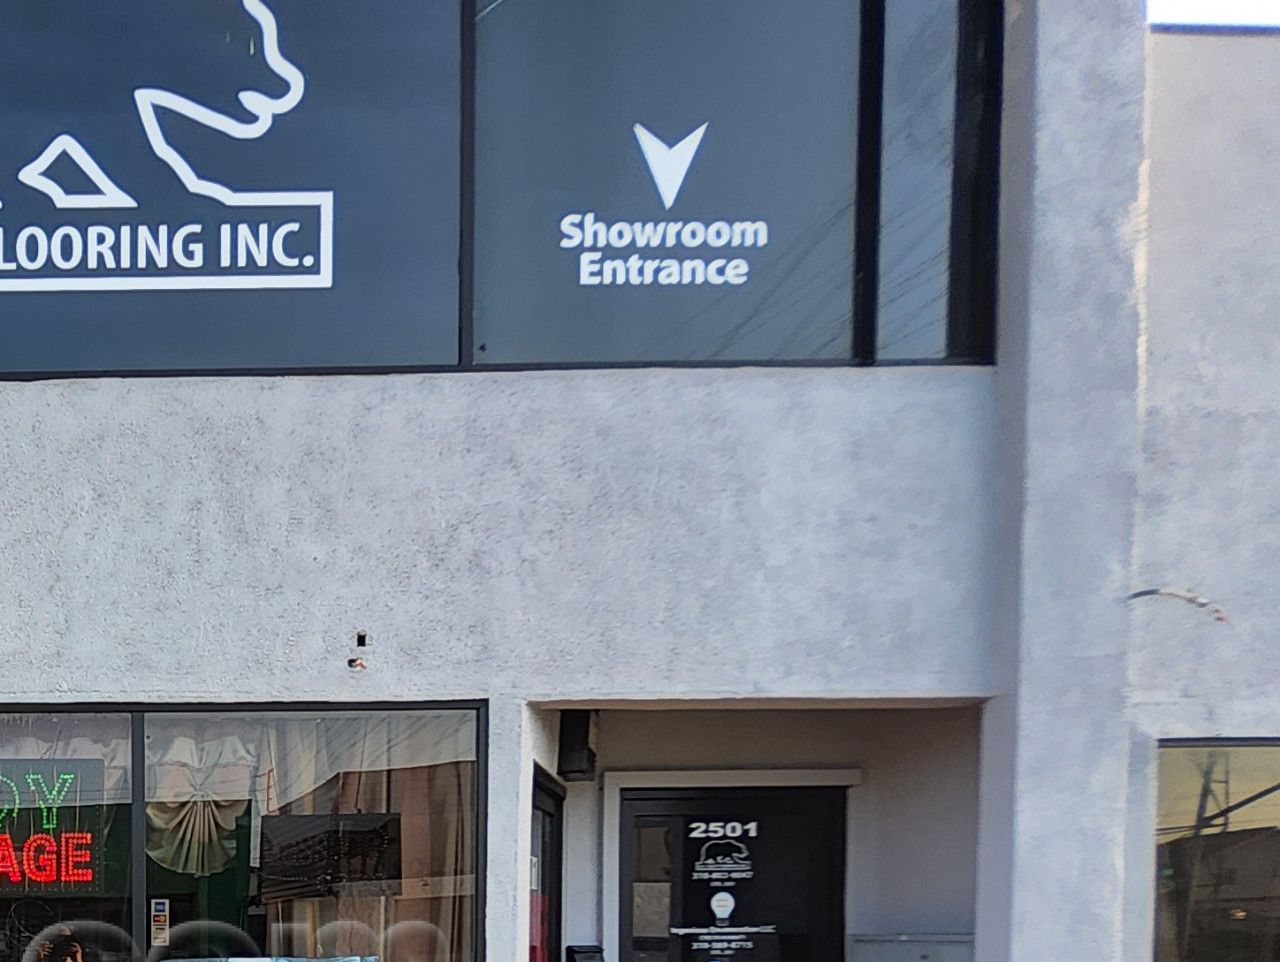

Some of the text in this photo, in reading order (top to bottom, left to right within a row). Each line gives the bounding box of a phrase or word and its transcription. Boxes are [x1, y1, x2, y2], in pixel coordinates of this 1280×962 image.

[220, 222, 315, 269] INC.
[559, 213, 768, 249] Showroom
[579, 251, 750, 286] Entrance
[688, 821, 759, 838] 2501
